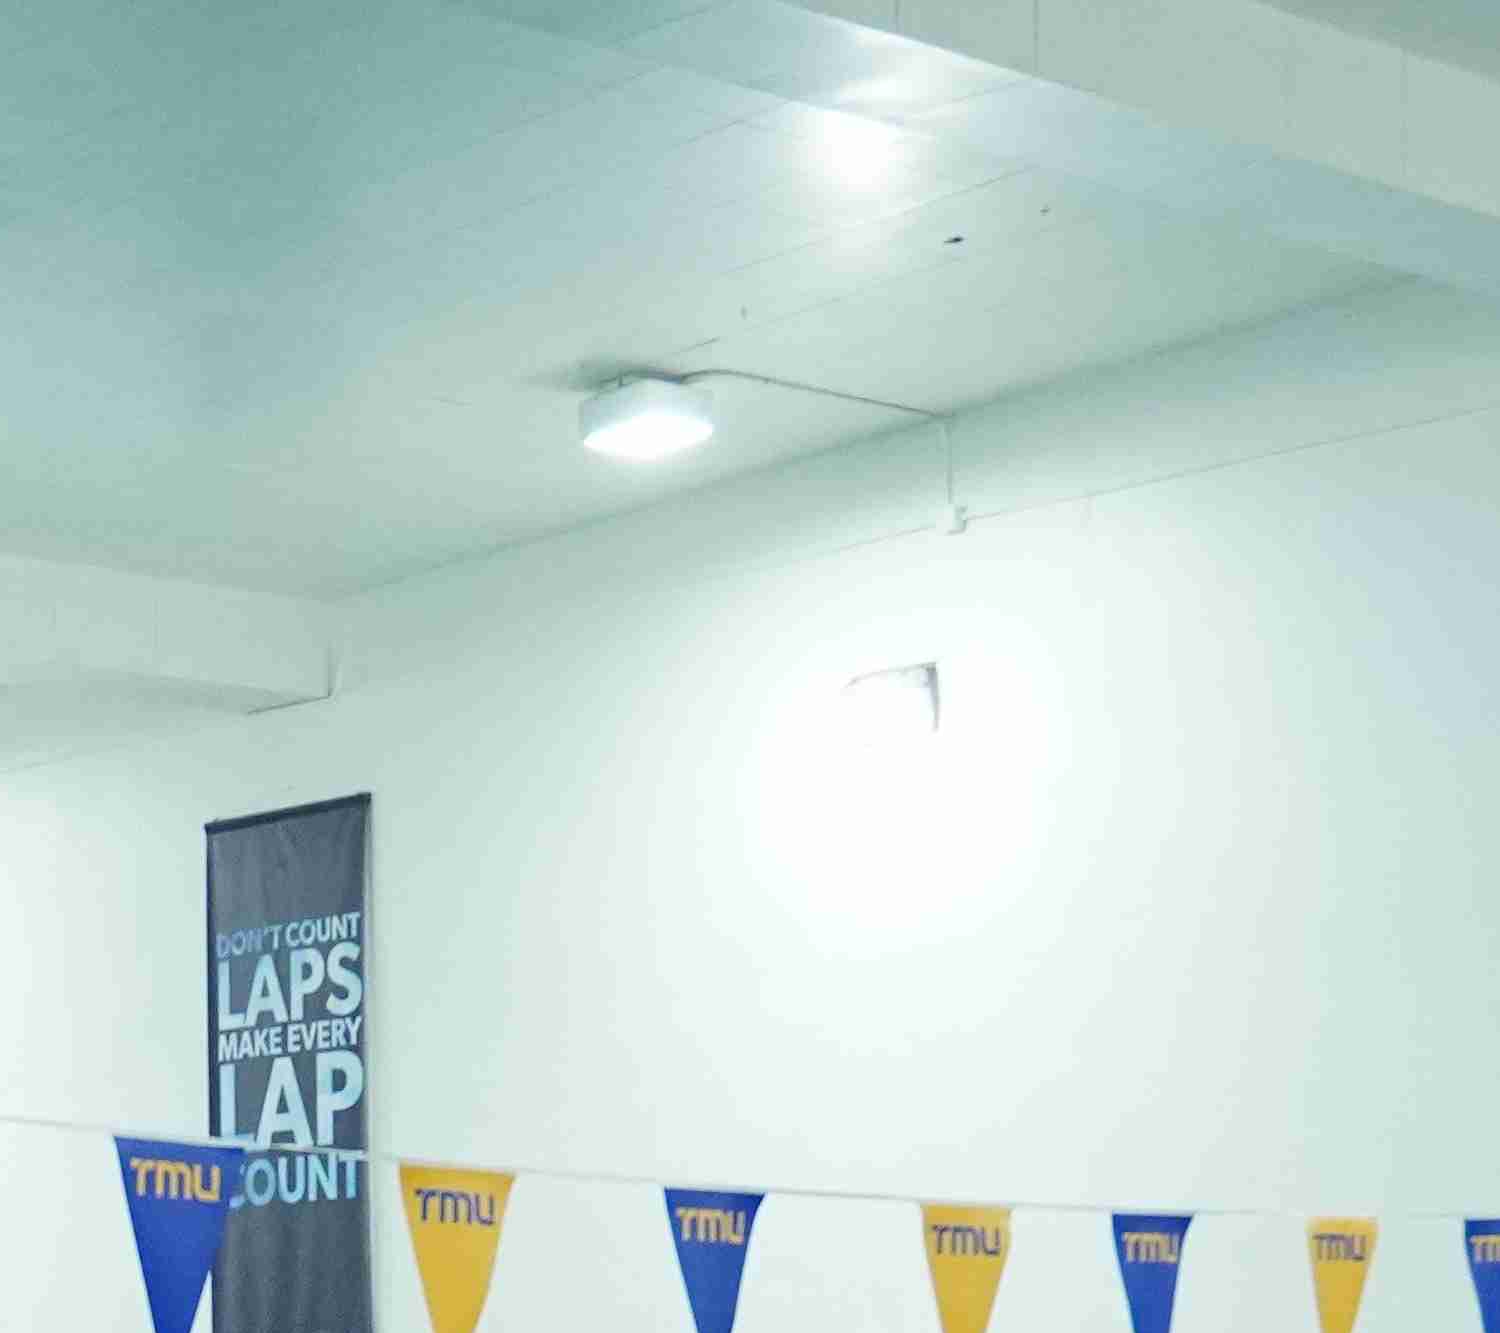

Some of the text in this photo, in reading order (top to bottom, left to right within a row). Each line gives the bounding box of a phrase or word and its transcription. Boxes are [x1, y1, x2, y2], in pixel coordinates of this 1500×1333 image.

[216, 912, 360, 959] DON'T COUNT
[218, 941, 363, 1031] LAPS
[218, 1015, 362, 1062] MAKE EVERY
[219, 1050, 364, 1152] LAP
[129, 1157, 221, 1202] TMU
[414, 1188, 496, 1226] TMU
[676, 1206, 746, 1245] TMU
[931, 1223, 1001, 1256] TMU
